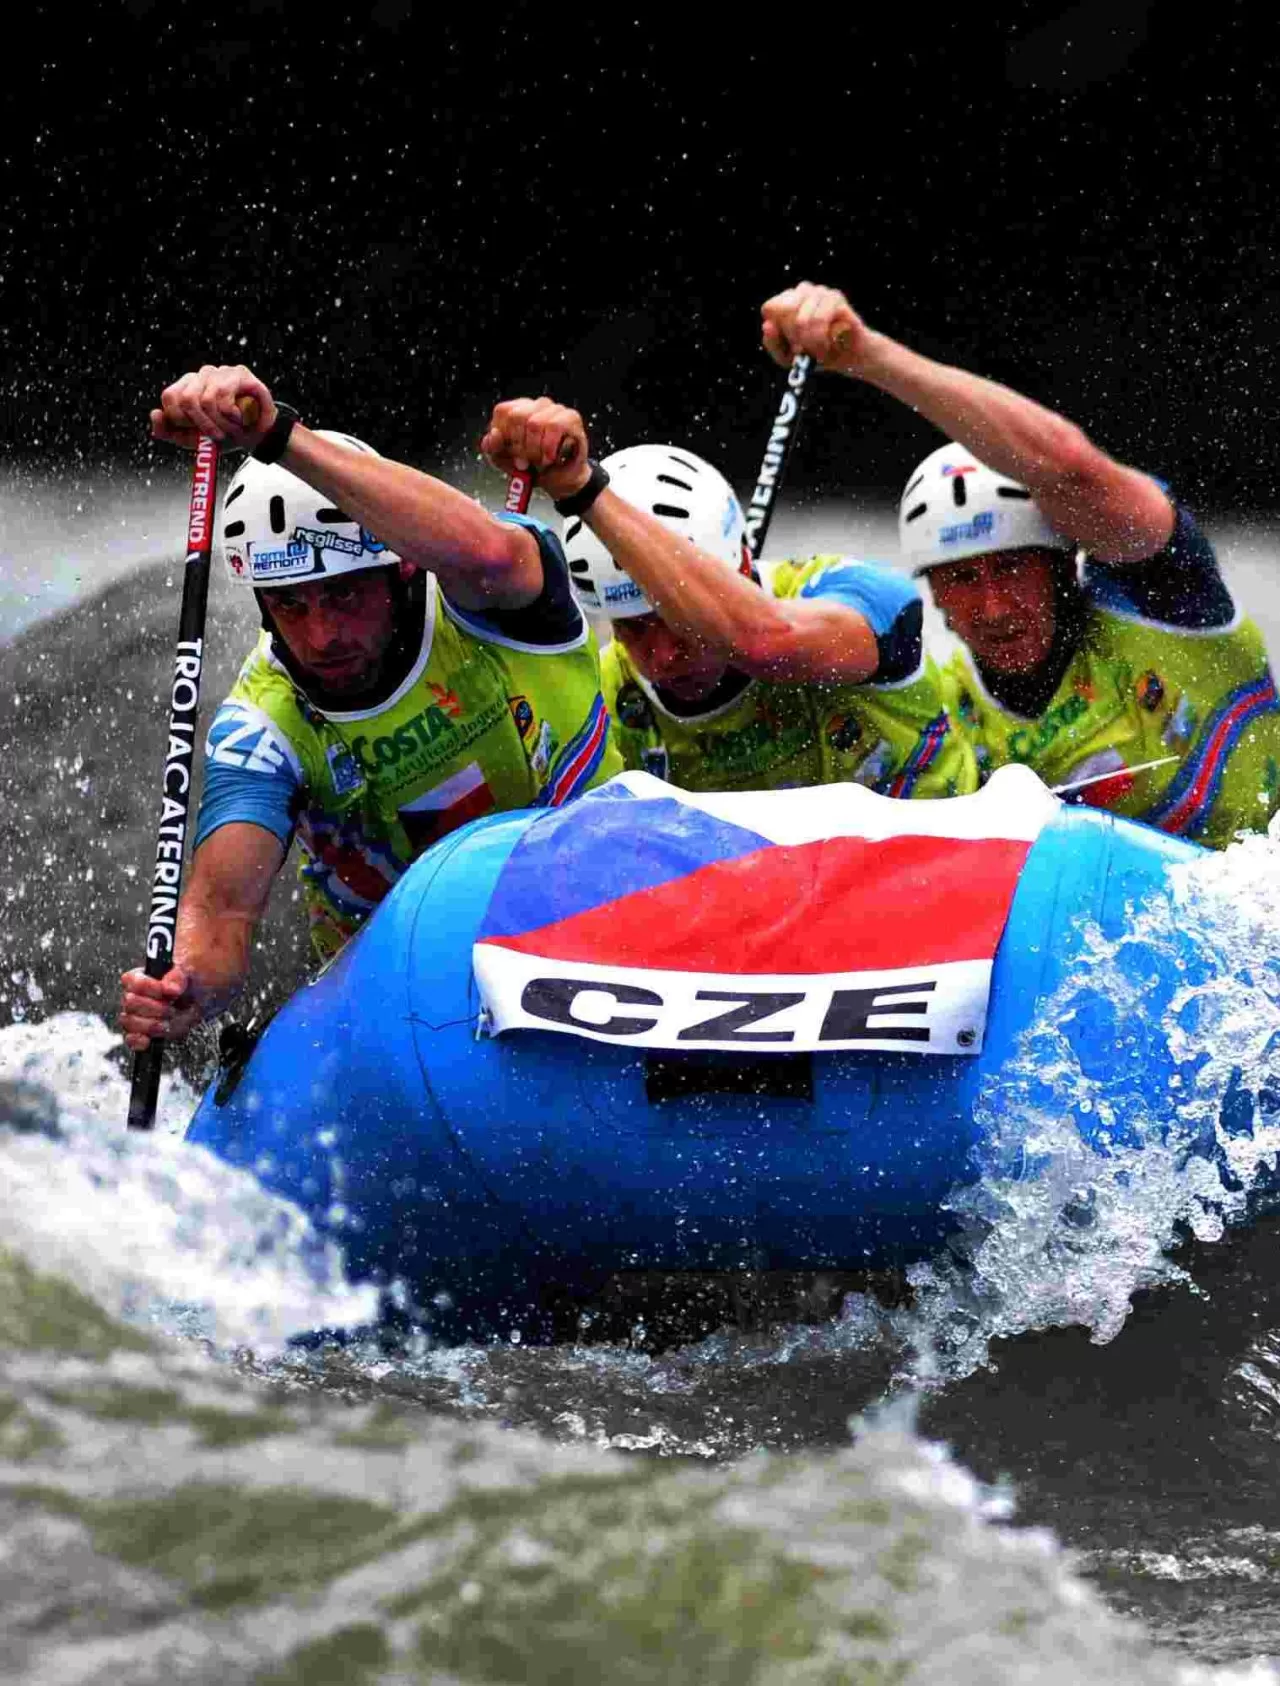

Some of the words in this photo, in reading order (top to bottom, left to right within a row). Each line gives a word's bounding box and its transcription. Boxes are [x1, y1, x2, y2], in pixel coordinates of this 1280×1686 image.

[189, 435, 213, 543] NUTREND
[146, 637, 203, 960] TROJACATERING
[520, 977, 938, 1043] CZE
